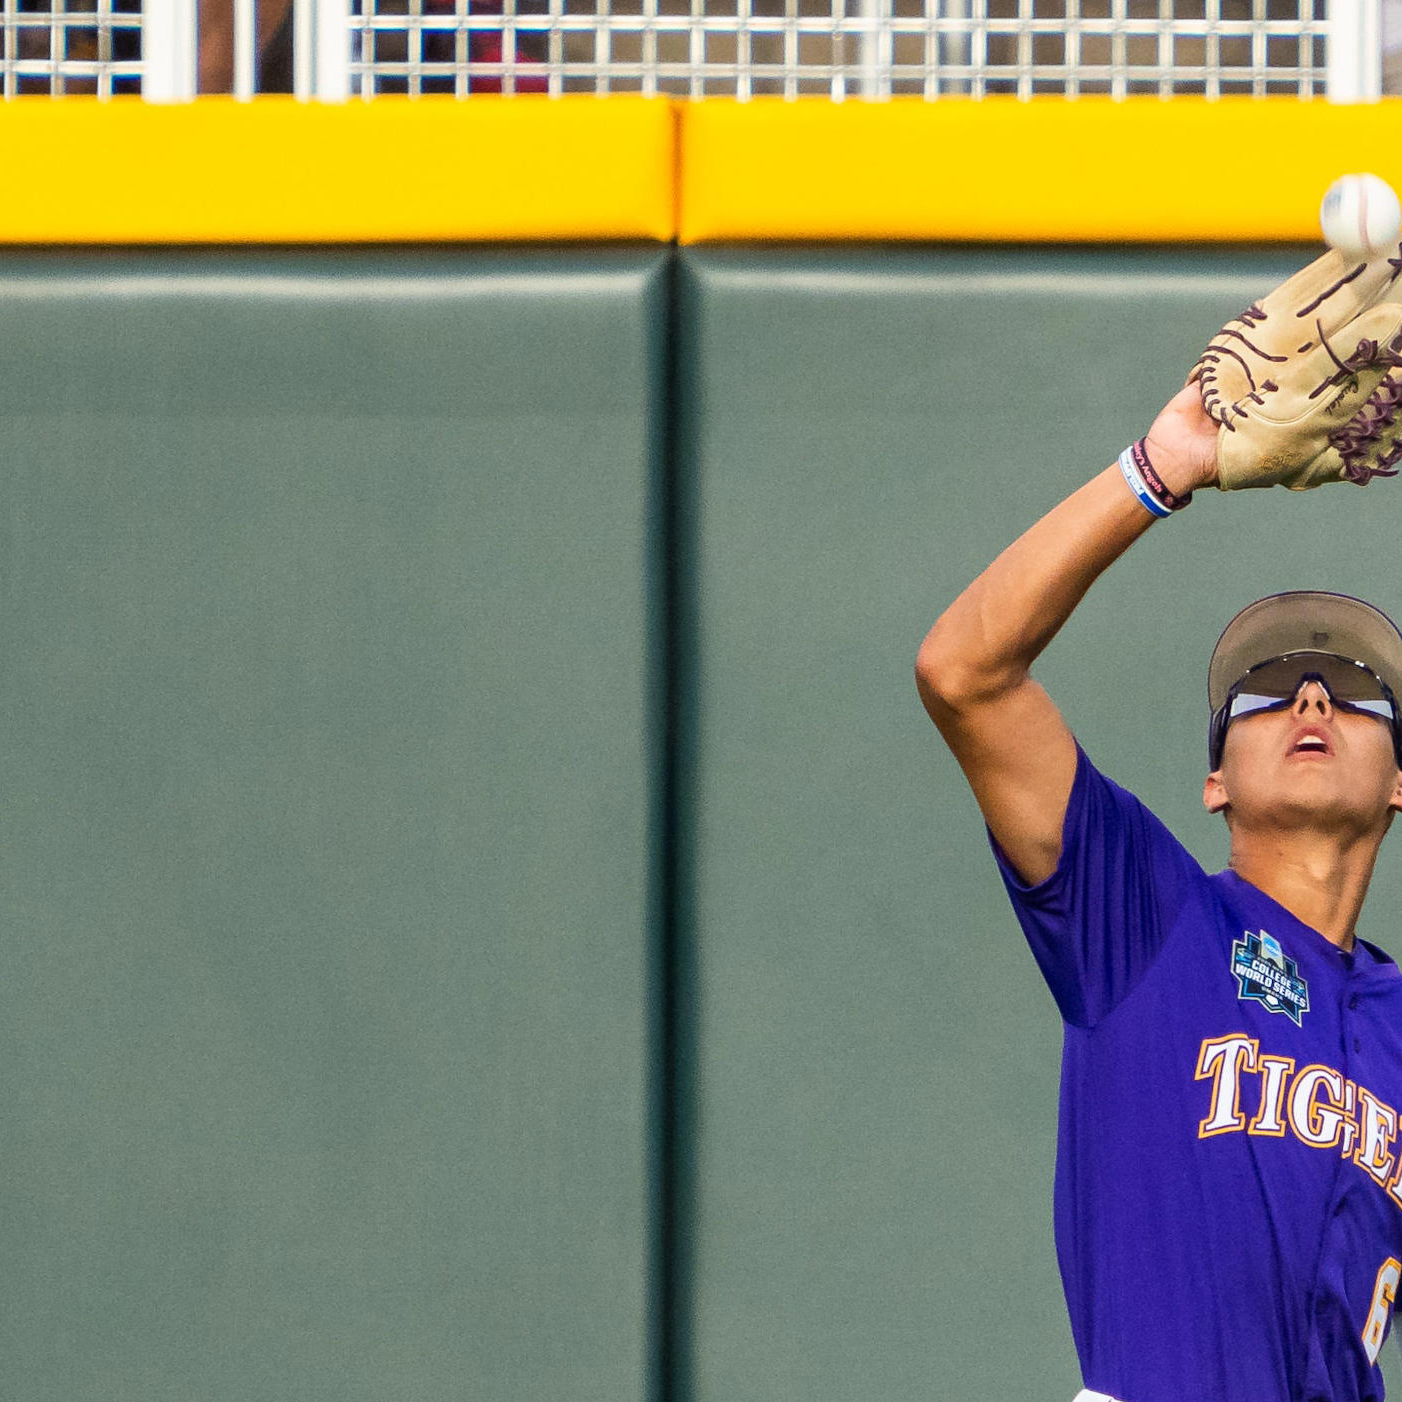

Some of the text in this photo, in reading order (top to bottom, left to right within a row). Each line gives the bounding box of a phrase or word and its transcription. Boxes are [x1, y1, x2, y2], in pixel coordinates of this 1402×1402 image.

[1235, 963, 1273, 988] WORLD
[1272, 980, 1307, 1008] SERIES
[1251, 959, 1292, 990] COLLEGE
